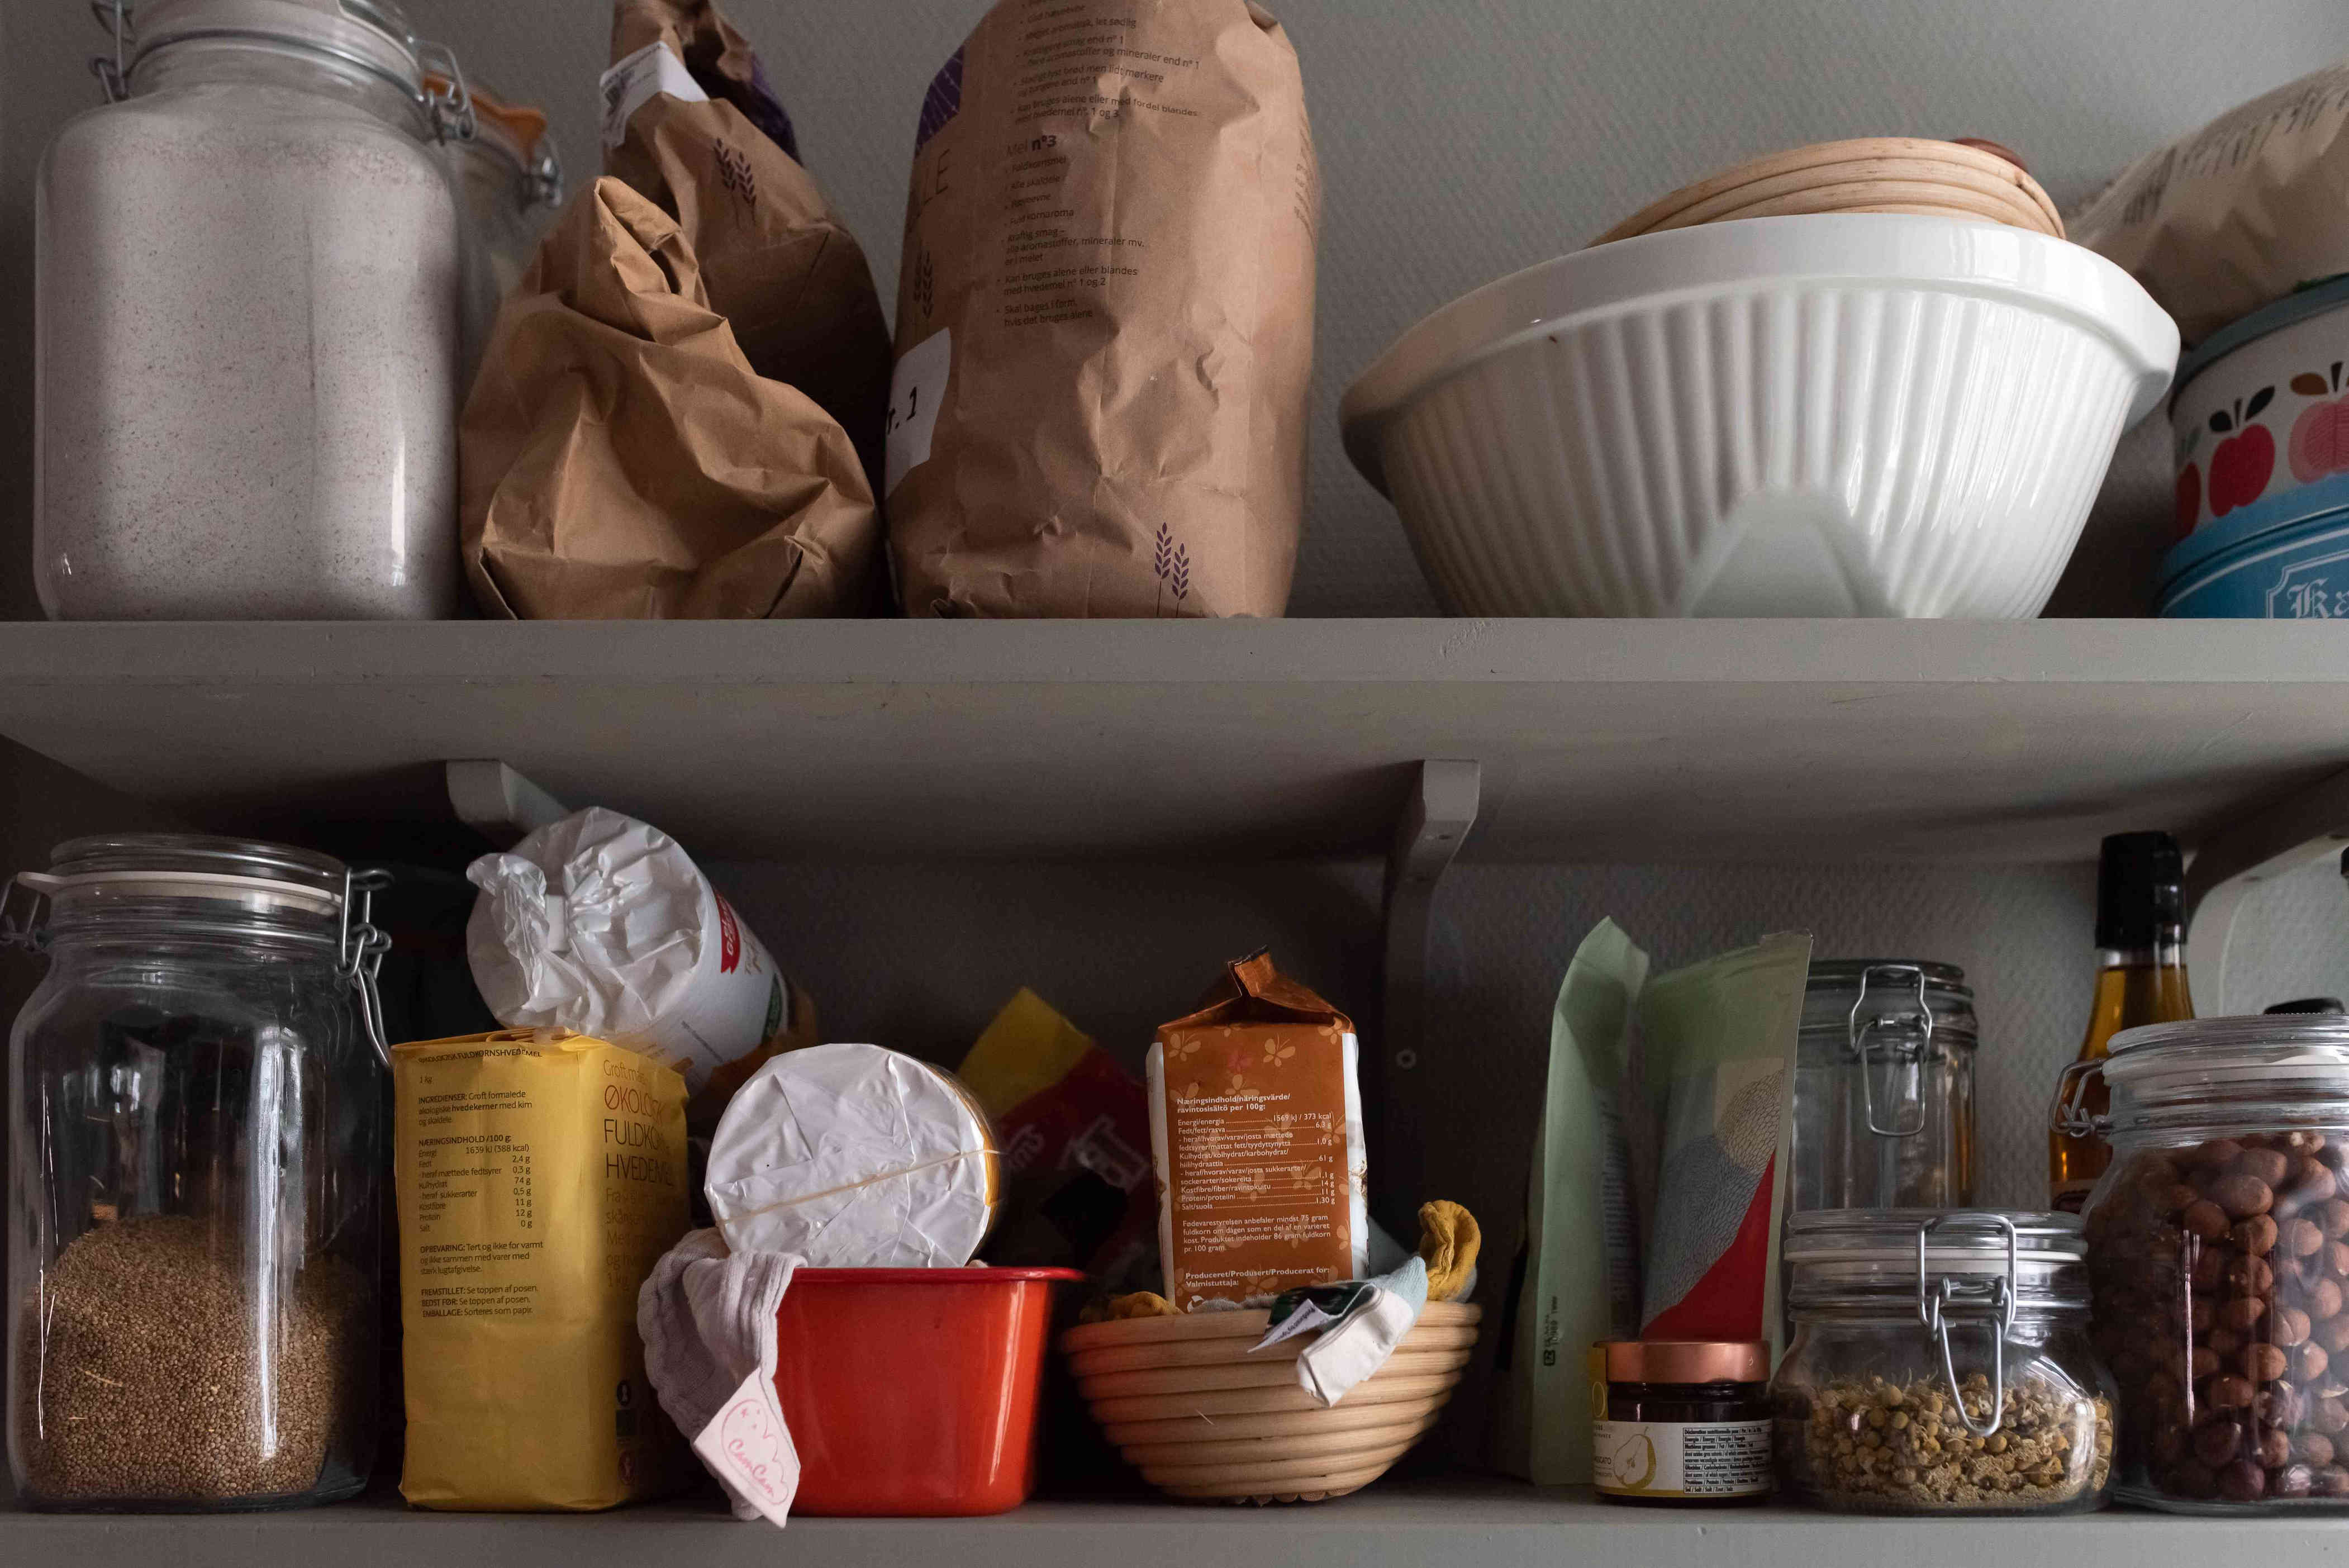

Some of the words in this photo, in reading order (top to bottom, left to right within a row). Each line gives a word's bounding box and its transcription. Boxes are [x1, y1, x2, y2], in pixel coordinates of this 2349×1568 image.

[1118, 47, 1162, 61] mineraler
[1163, 56, 1181, 66] end
[1125, 68, 1164, 83] mørkere
[1089, 94, 1109, 103] eller
[1133, 98, 1159, 111] fordel
[1081, 236, 1125, 247] mineraler
[1054, 267, 1077, 276] alene
[1079, 265, 1100, 275] eller
[1101, 265, 1138, 275] blandes
[1086, 279, 1097, 288] og
[425, 1075, 432, 1084] kg
[419, 1094, 467, 1104] INGREDIENSER:
[488, 1091, 526, 1099] formalede
[1177, 1093, 1291, 1105] Næringsindhold/näringsvärde/
[452, 1103, 498, 1113] hvedekerner
[1230, 1104, 1243, 1114] per
[1246, 1103, 1266, 1111] 100g:
[1178, 1118, 1224, 1127] Energi/energia
[1273, 1114, 1289, 1122] 1569
[1178, 1126, 1226, 1135] Fedt/fett/rasva
[419, 1135, 484, 1147] NÆRINGSINDHOLD
[494, 1145, 511, 1154] (388
[512, 1144, 530, 1152] kcal)
[1180, 1149, 1288, 1160] Kulhydrat/kolhydrat/karbohydrat/
[471, 1167, 502, 1177] fedtsyrer
[1185, 1167, 1264, 1177] heraf/hvorav/varav/josta
[1183, 1218, 1243, 1228] Fødevarestyrelsen
[1244, 1216, 1275, 1225] anbefaler
[1225, 1227, 1245, 1236] dagen
[1201, 1235, 1235, 1244] Produktet
[1236, 1233, 1272, 1242] indeholder
[1284, 1233, 1301, 1241] gram
[420, 1244, 465, 1253] OPBEVARING:
[1208, 1244, 1226, 1253] gram.
[1186, 1279, 1239, 1288] Valmistuttaja:
[421, 1287, 465, 1296] FREMSTILLET:
[477, 1285, 503, 1295] toppen
[505, 1284, 512, 1293] af
[469, 1297, 495, 1306] toppen
[505, 1296, 530, 1305] posen.
[464, 1308, 493, 1316] Sorteres
[512, 1306, 533, 1316] papir.
